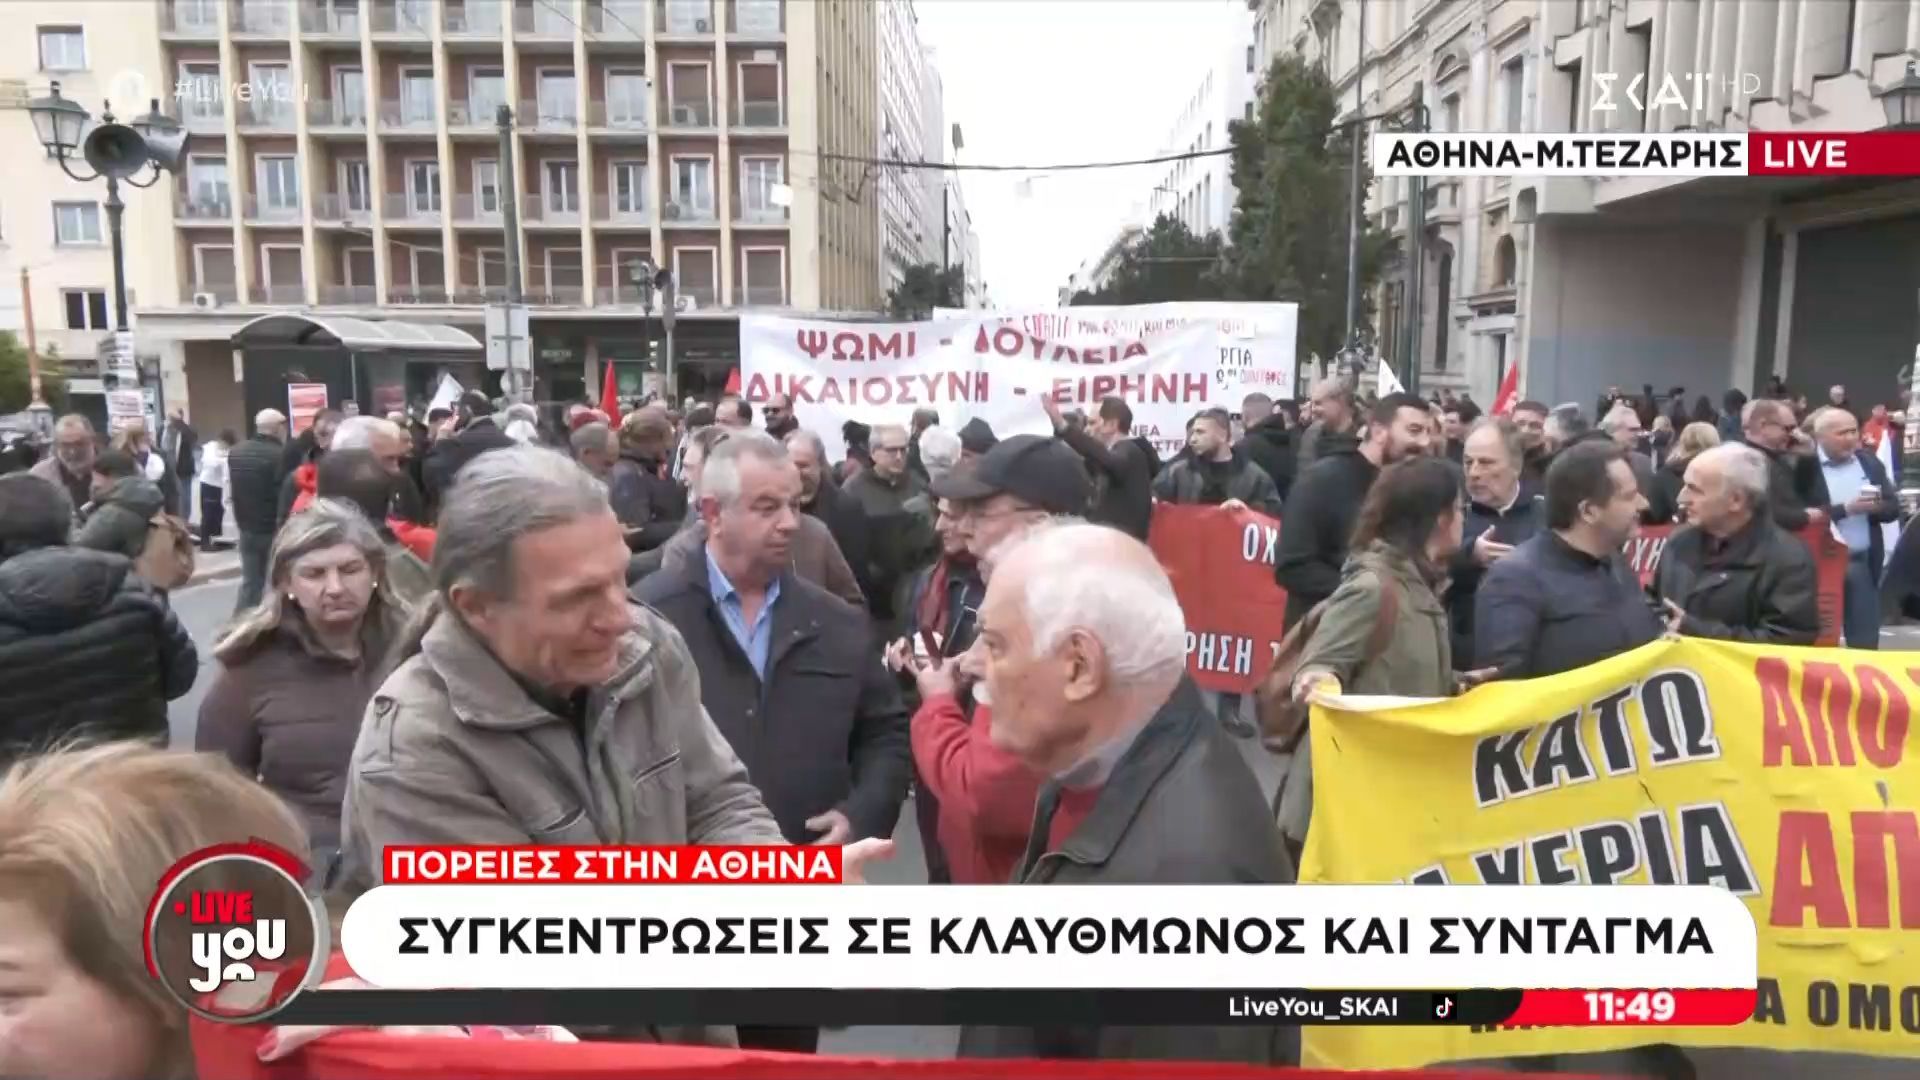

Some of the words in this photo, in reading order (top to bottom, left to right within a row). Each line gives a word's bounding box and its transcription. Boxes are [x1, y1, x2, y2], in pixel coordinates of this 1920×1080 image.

[797, 328, 916, 361] ΨΩΜΙ
[1217, 347, 1253, 367] ΡΓΙΑ
[746, 369, 990, 405] ΔΙΚΑΙΟΣΥΝΗ
[1050, 372, 1209, 403] ΕΙΡΗΝΗ
[1242, 522, 1279, 566] ΟΧ
[1622, 535, 1667, 573] ΧΗ
[1184, 630, 1254, 676] ΡΗΣΗ
[1473, 667, 1721, 808] ΚΑΤΩ
[1755, 656, 1910, 769] ΑΠΟ
